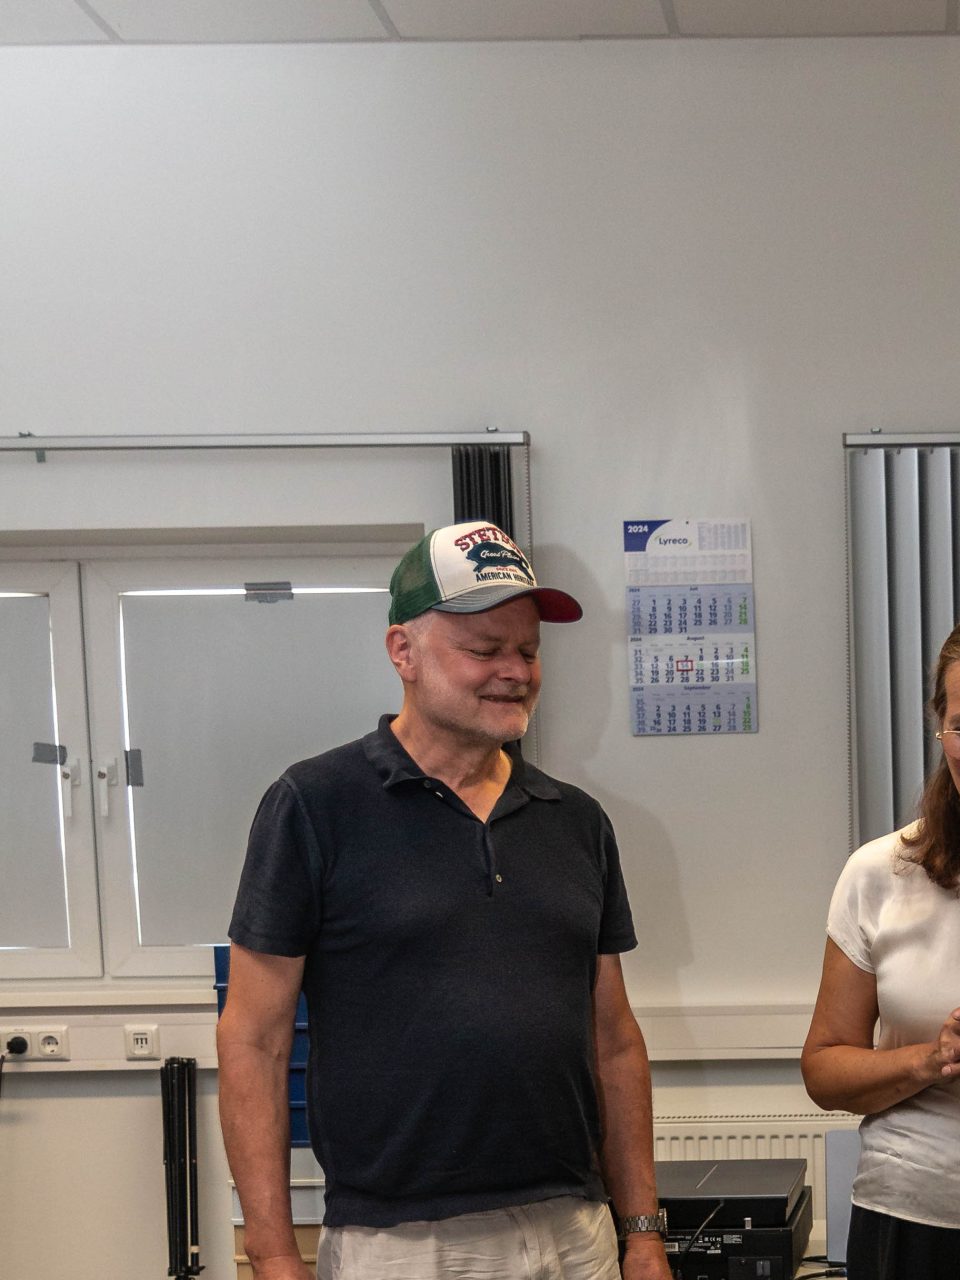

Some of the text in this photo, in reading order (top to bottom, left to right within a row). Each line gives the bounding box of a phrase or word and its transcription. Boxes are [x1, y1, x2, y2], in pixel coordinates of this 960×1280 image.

[628, 525, 649, 533] 2024
[659, 538, 688, 546] Lyreco
[476, 572, 512, 583] AMERICAN
